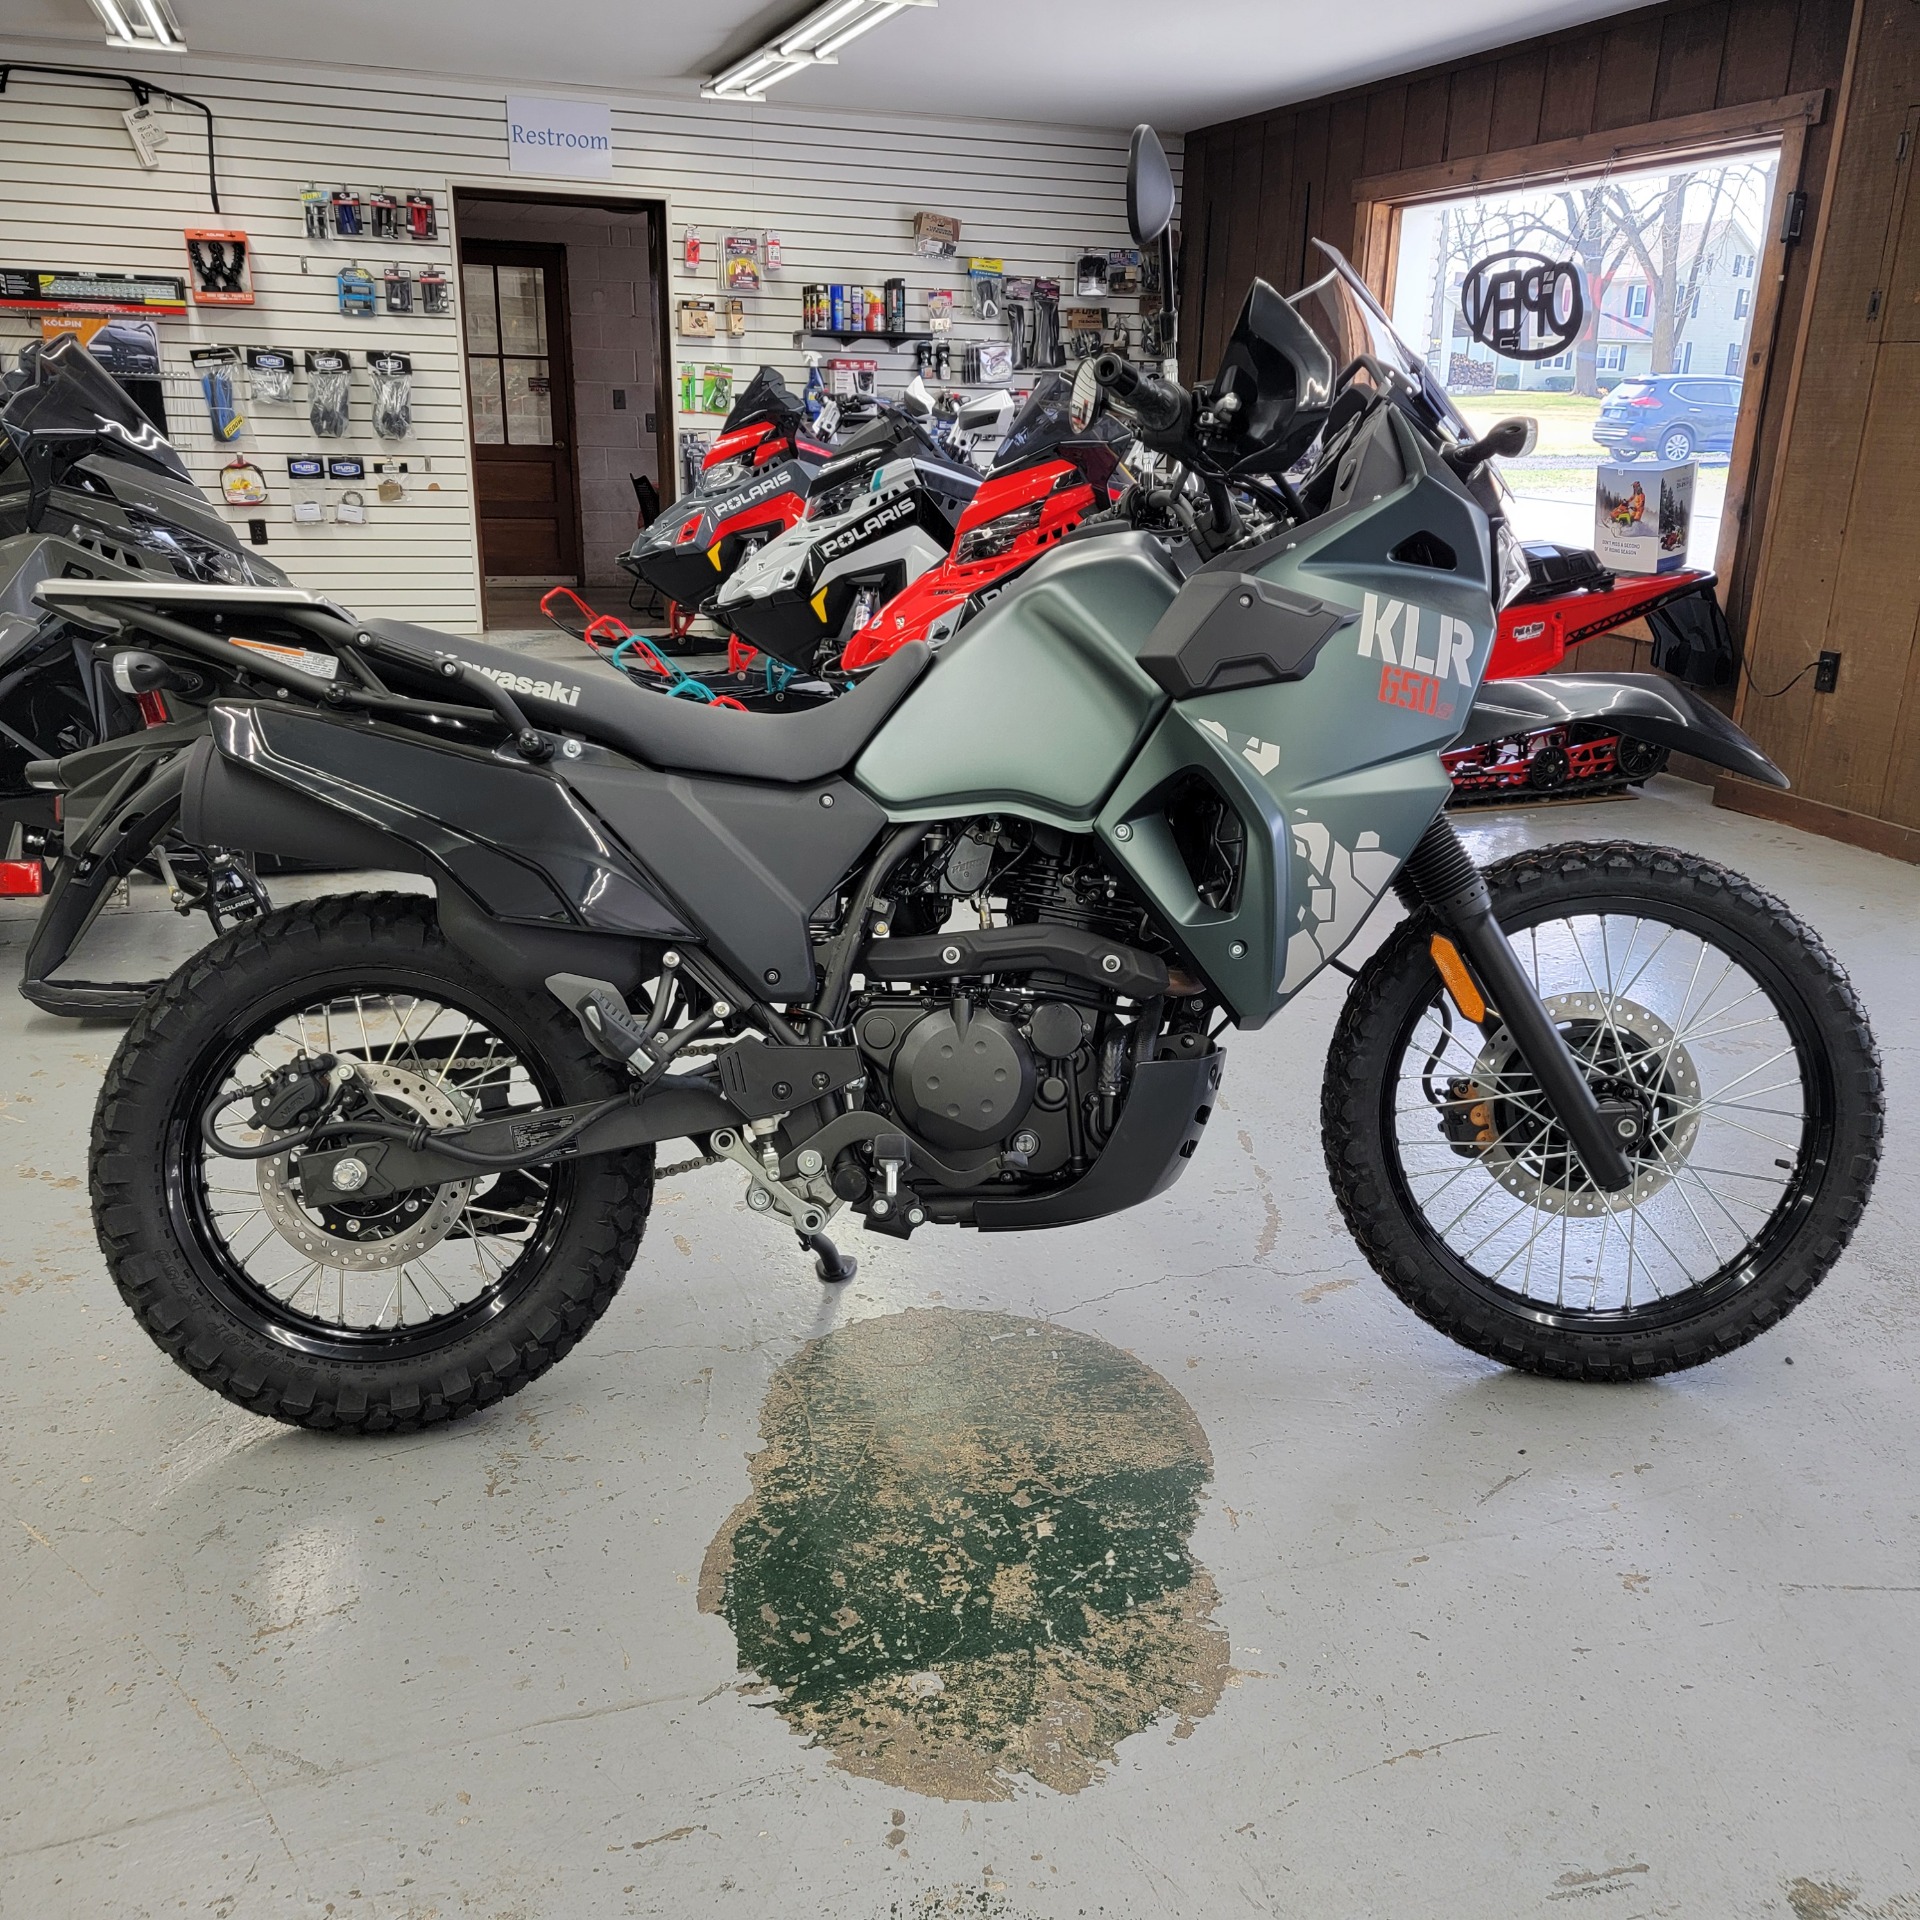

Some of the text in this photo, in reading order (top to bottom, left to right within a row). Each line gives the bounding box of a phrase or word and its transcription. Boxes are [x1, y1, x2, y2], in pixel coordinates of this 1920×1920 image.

[511, 124, 609, 150] Restroom
[43, 319, 82, 328] KOLPIN
[714, 470, 792, 517] POLARIS
[820, 497, 916, 557] POLARIS
[1357, 592, 1475, 687] KLR
[1377, 664, 1440, 716] 650
[218, 897, 255, 913] POLARIS
